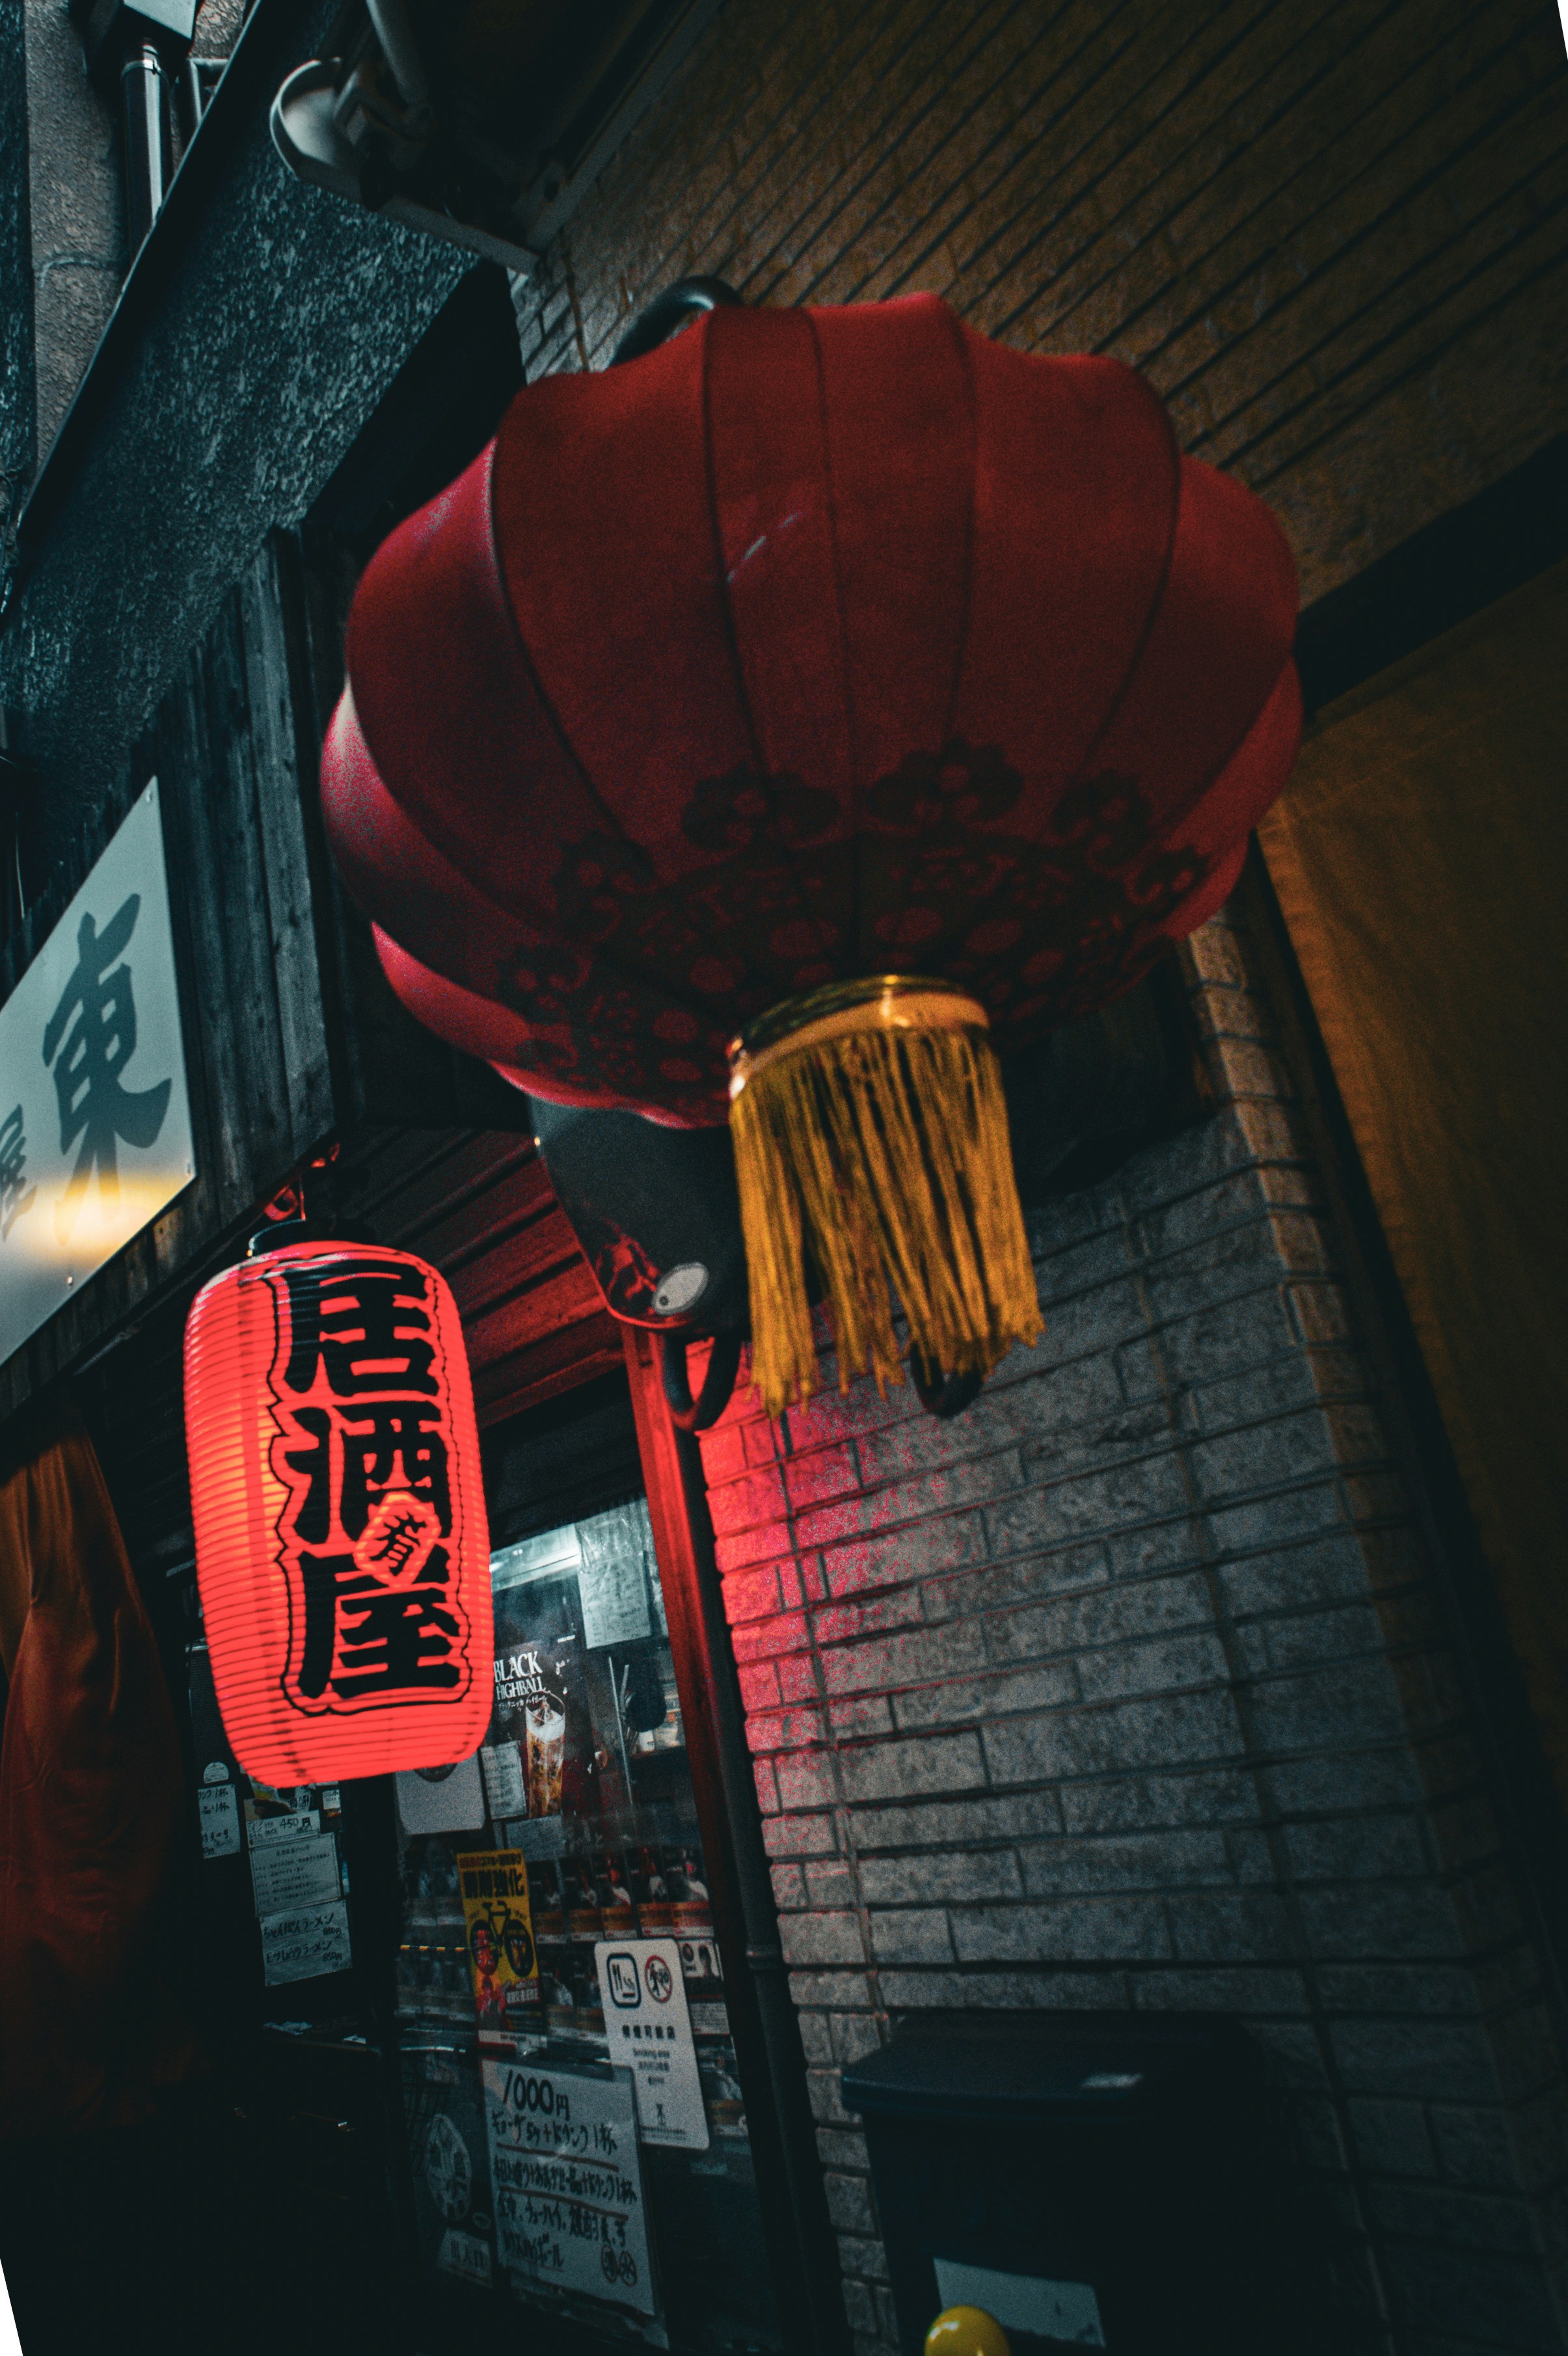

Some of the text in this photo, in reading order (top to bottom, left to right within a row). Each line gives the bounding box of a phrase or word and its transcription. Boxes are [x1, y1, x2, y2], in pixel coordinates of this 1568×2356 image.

[42, 893, 172, 1245] 東
[282, 1260, 462, 1699] 居酒屋
[493, 1651, 543, 1683] BLACK
[496, 1677, 547, 1701] HIGHBALL
[503, 2070, 570, 2121] 1000円
